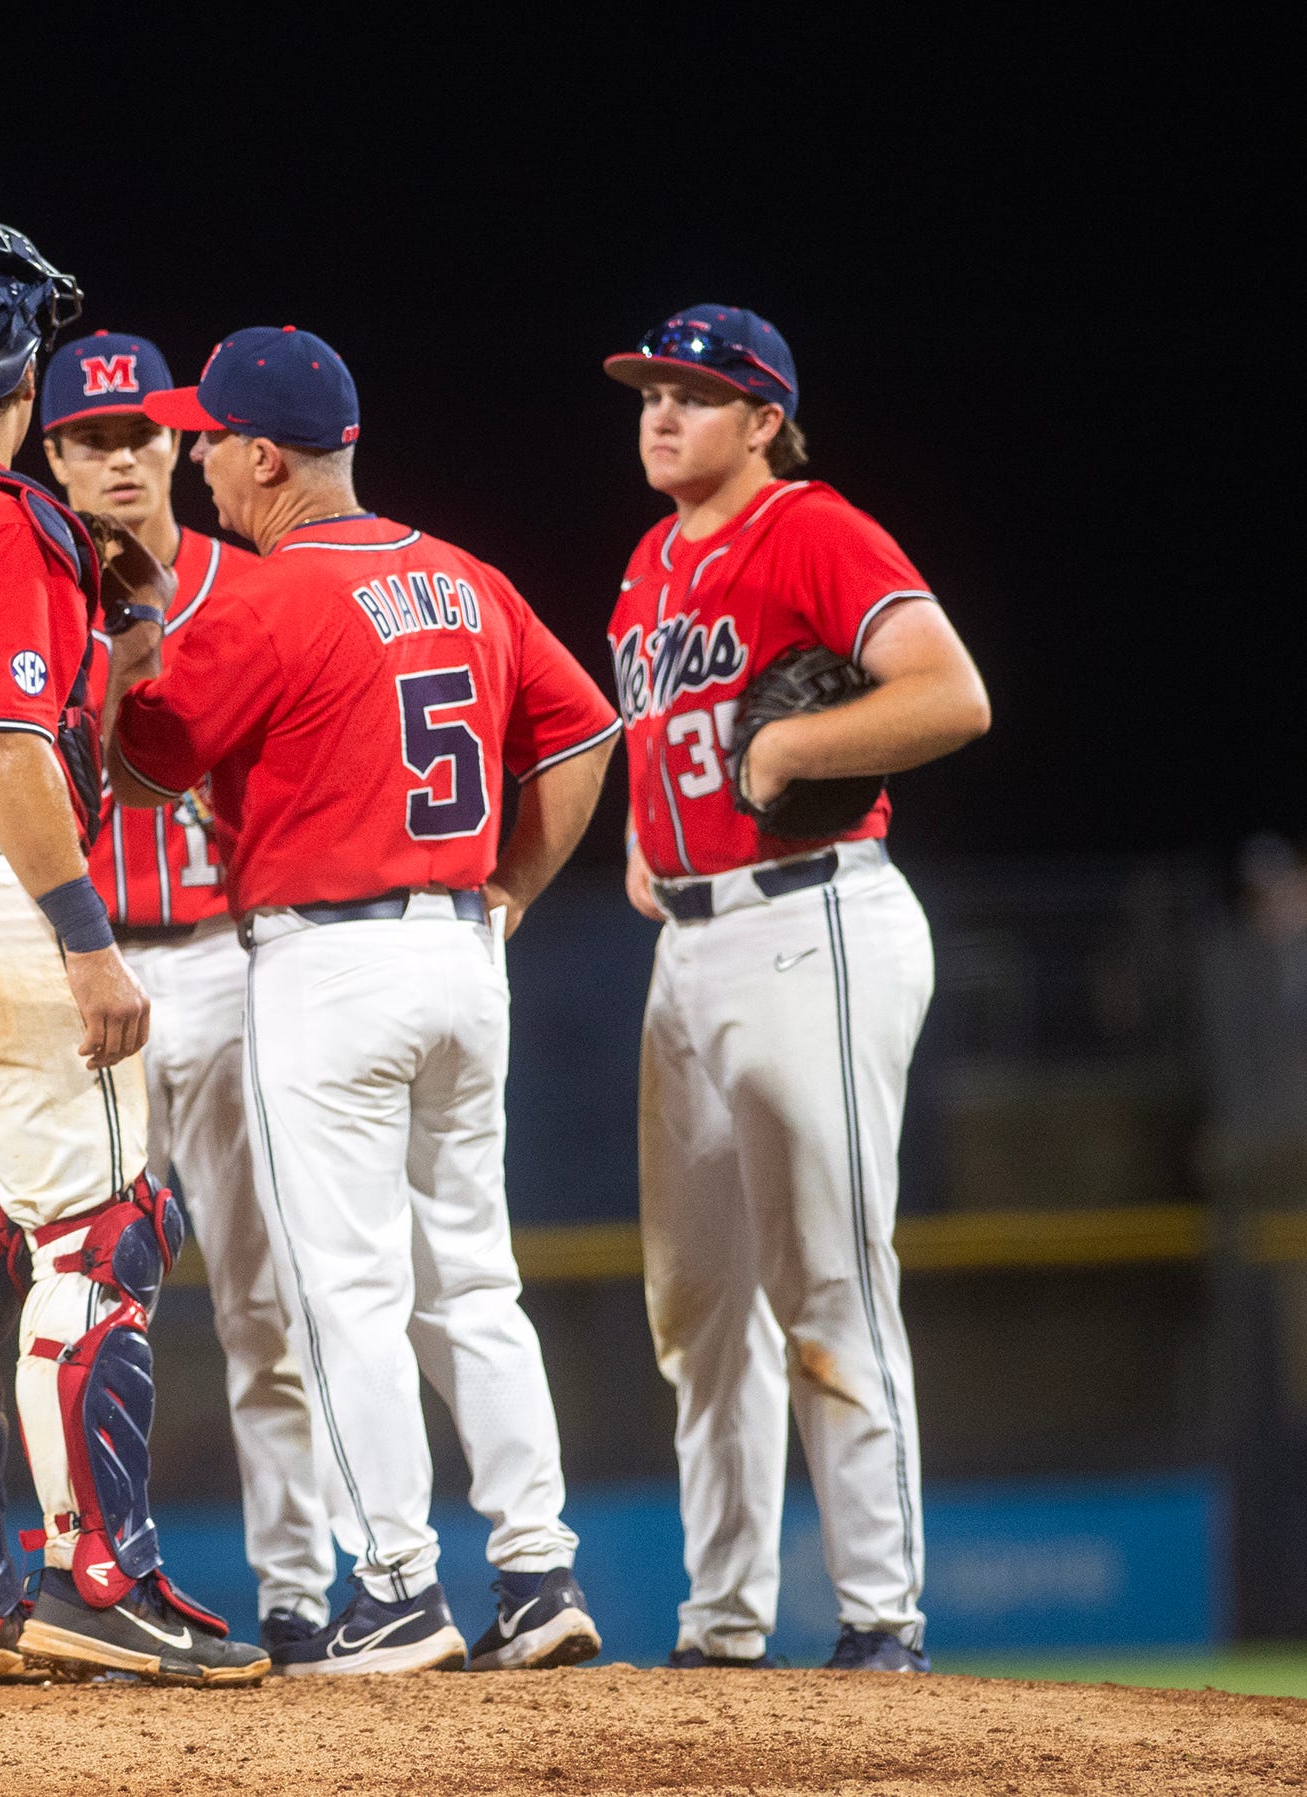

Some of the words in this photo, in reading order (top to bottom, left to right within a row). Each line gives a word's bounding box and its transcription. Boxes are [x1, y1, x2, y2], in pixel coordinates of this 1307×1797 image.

[80, 354, 139, 396] M
[352, 572, 481, 645] BIANCO
[12, 651, 46, 694] SEC
[395, 664, 491, 841] 5
